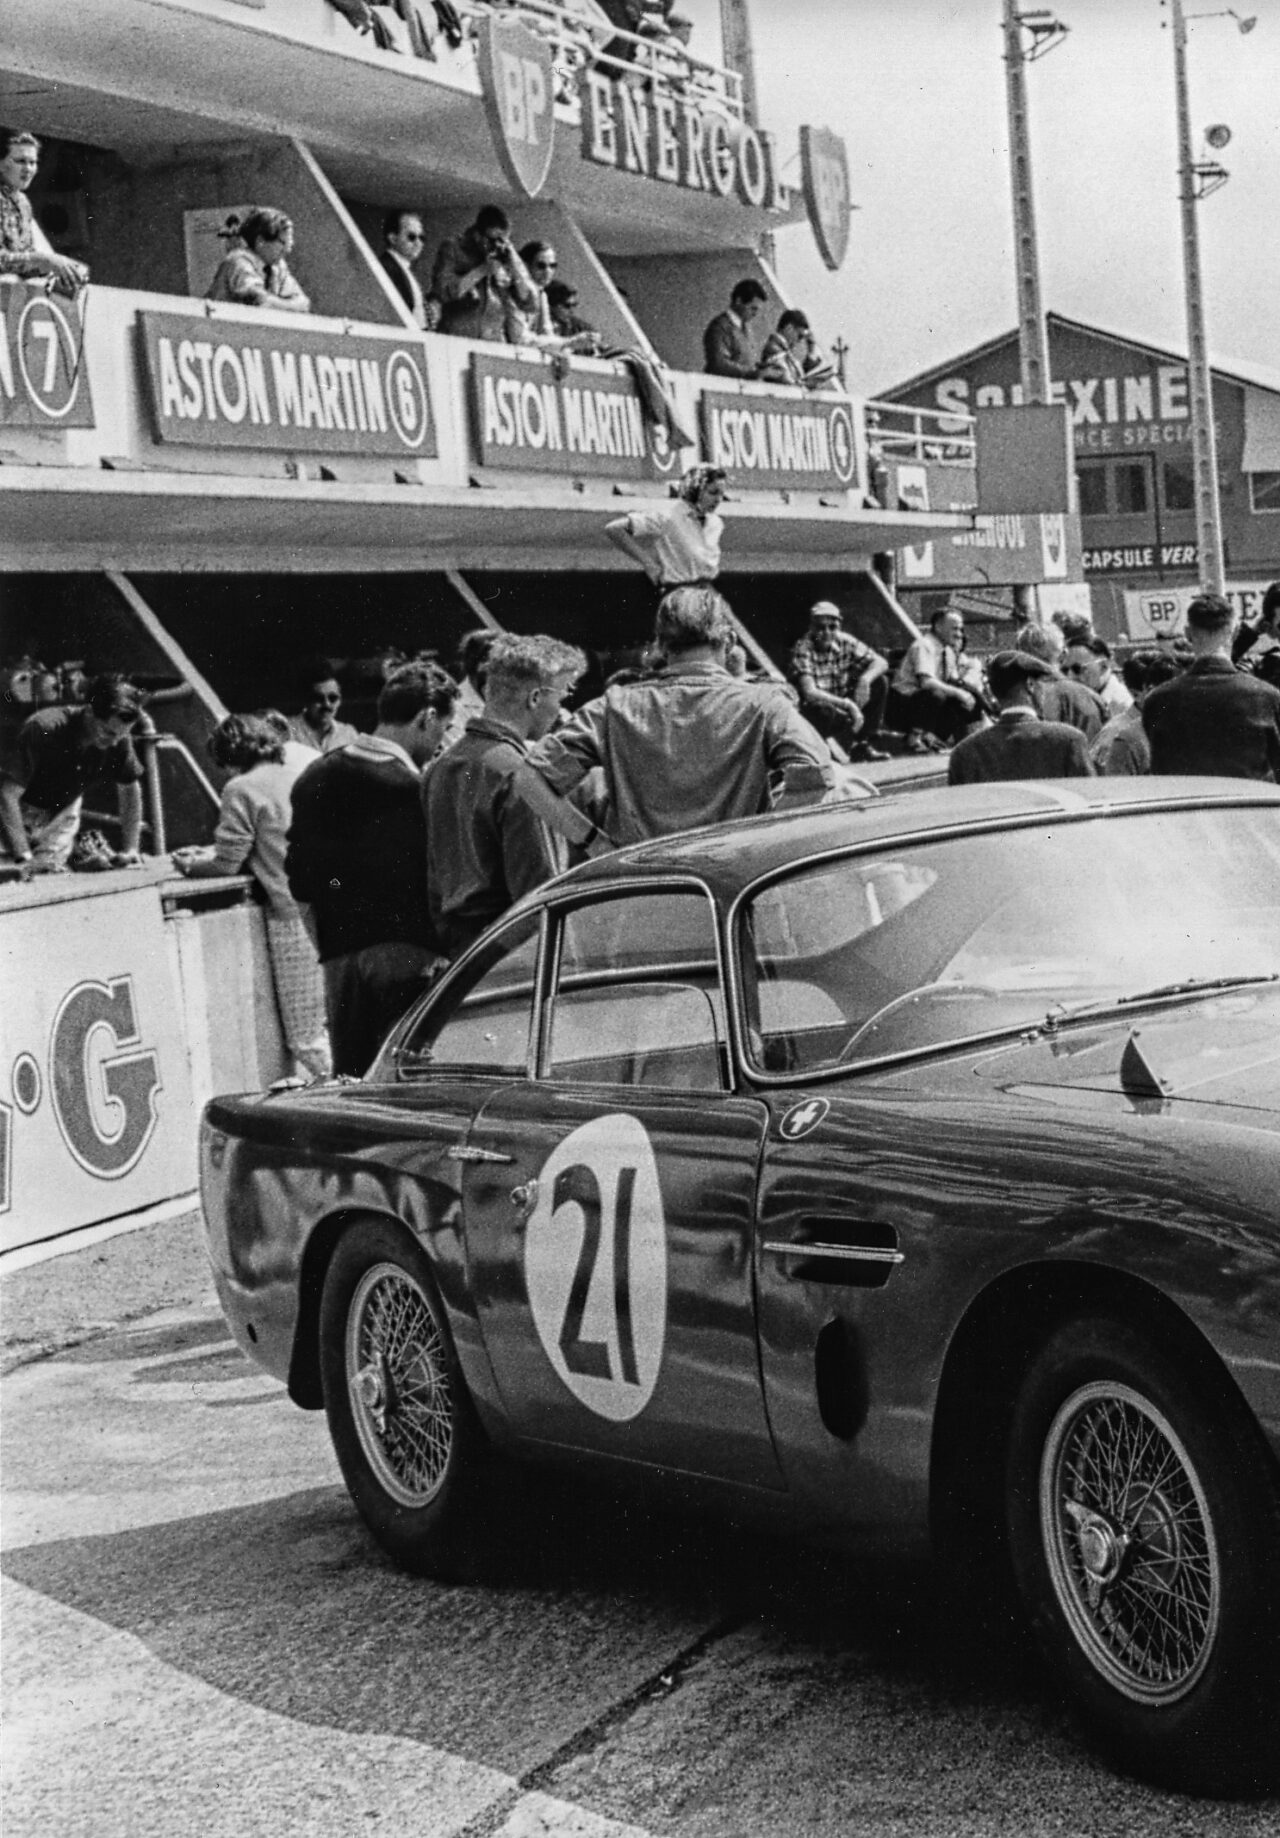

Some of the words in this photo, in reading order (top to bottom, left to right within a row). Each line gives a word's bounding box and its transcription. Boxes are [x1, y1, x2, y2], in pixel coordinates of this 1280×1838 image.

[499, 51, 546, 145] BP
[586, 69, 790, 211] ENERGOL
[31, 320, 59, 393] 7
[158, 337, 271, 425] ASTON
[270, 349, 389, 433] MARTIN
[395, 366, 419, 431] 6
[483, 375, 562, 450] ASTON
[562, 386, 646, 457] MARTIN
[712, 407, 770, 469] ASTON
[769, 413, 831, 472] MARTIN
[1081, 547, 1154, 569] CAPSULE
[1160, 545, 1201, 565] VER
[1149, 601, 1176, 622] BP
[550, 1162, 642, 1387] 21
